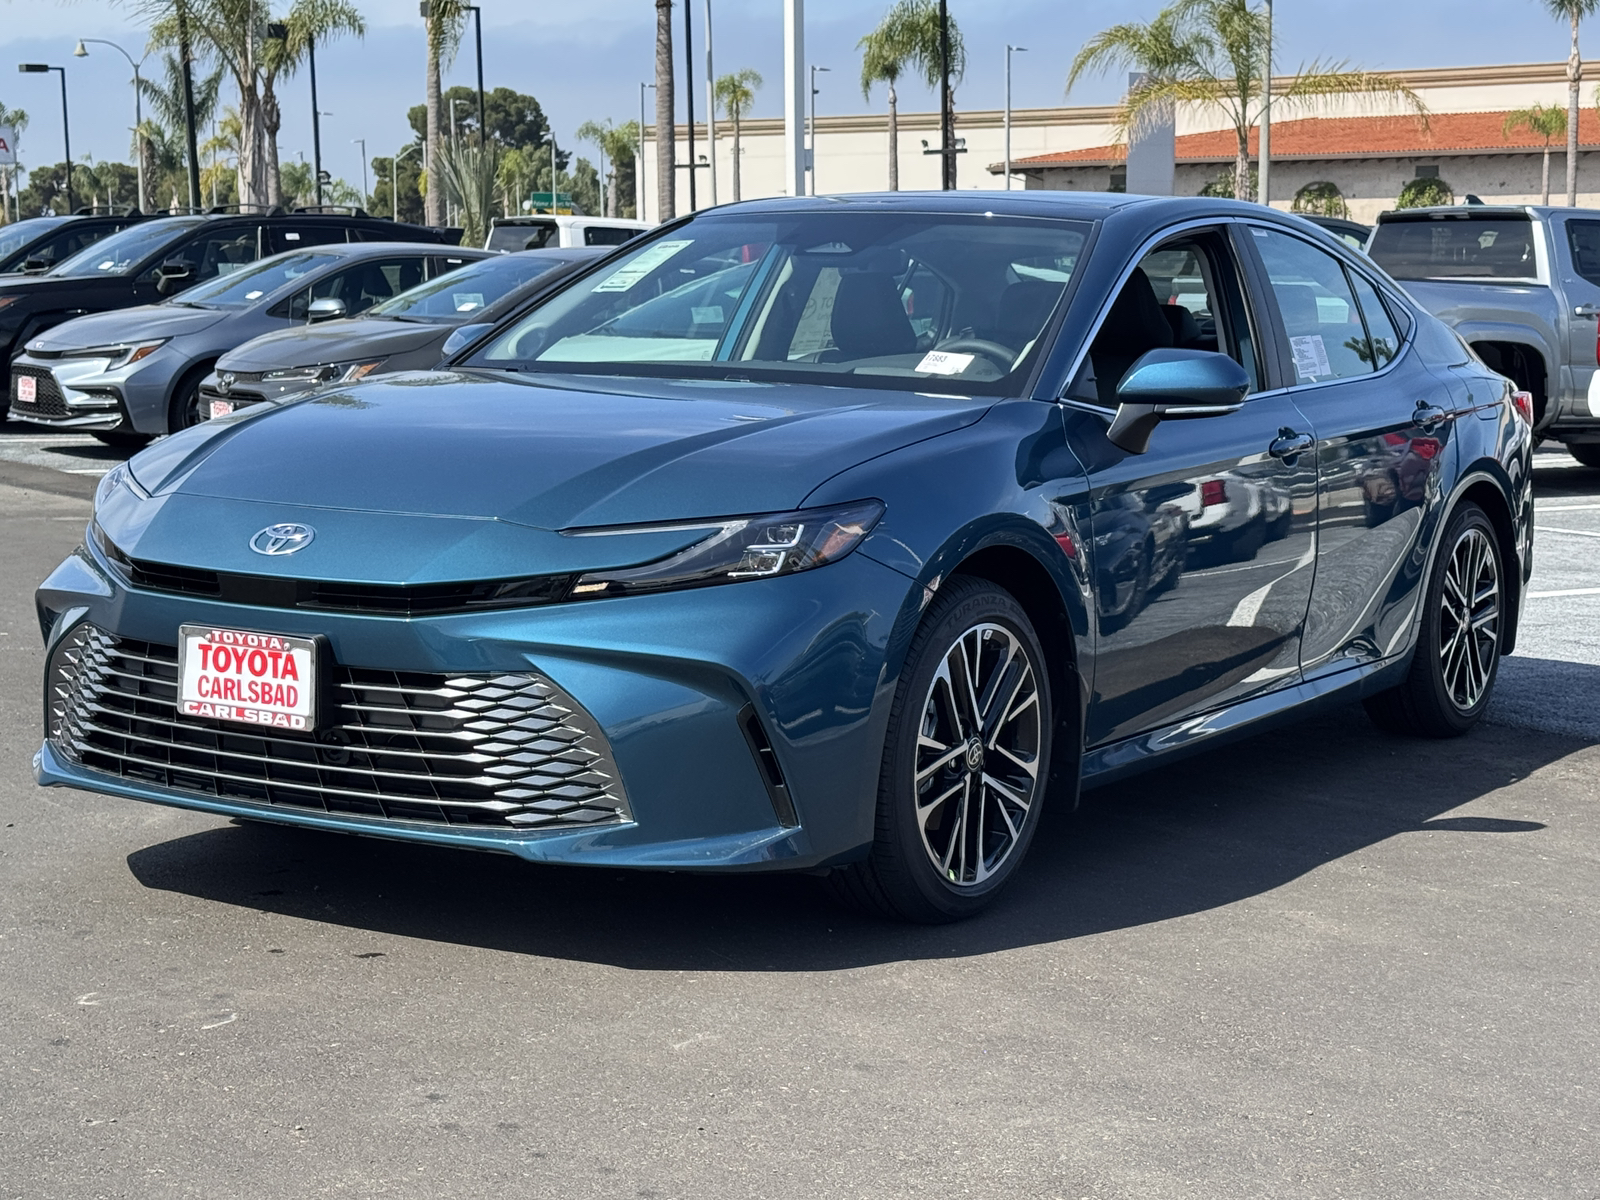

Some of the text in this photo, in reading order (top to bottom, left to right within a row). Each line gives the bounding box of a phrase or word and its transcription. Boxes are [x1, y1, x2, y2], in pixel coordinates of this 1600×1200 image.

[944, 595, 1007, 630] TURANZA
[212, 631, 282, 649] TOYOTA
[198, 643, 299, 681] TOYOTA
[198, 675, 299, 708] CARLSBAD
[184, 701, 306, 729] CARLSBAD
